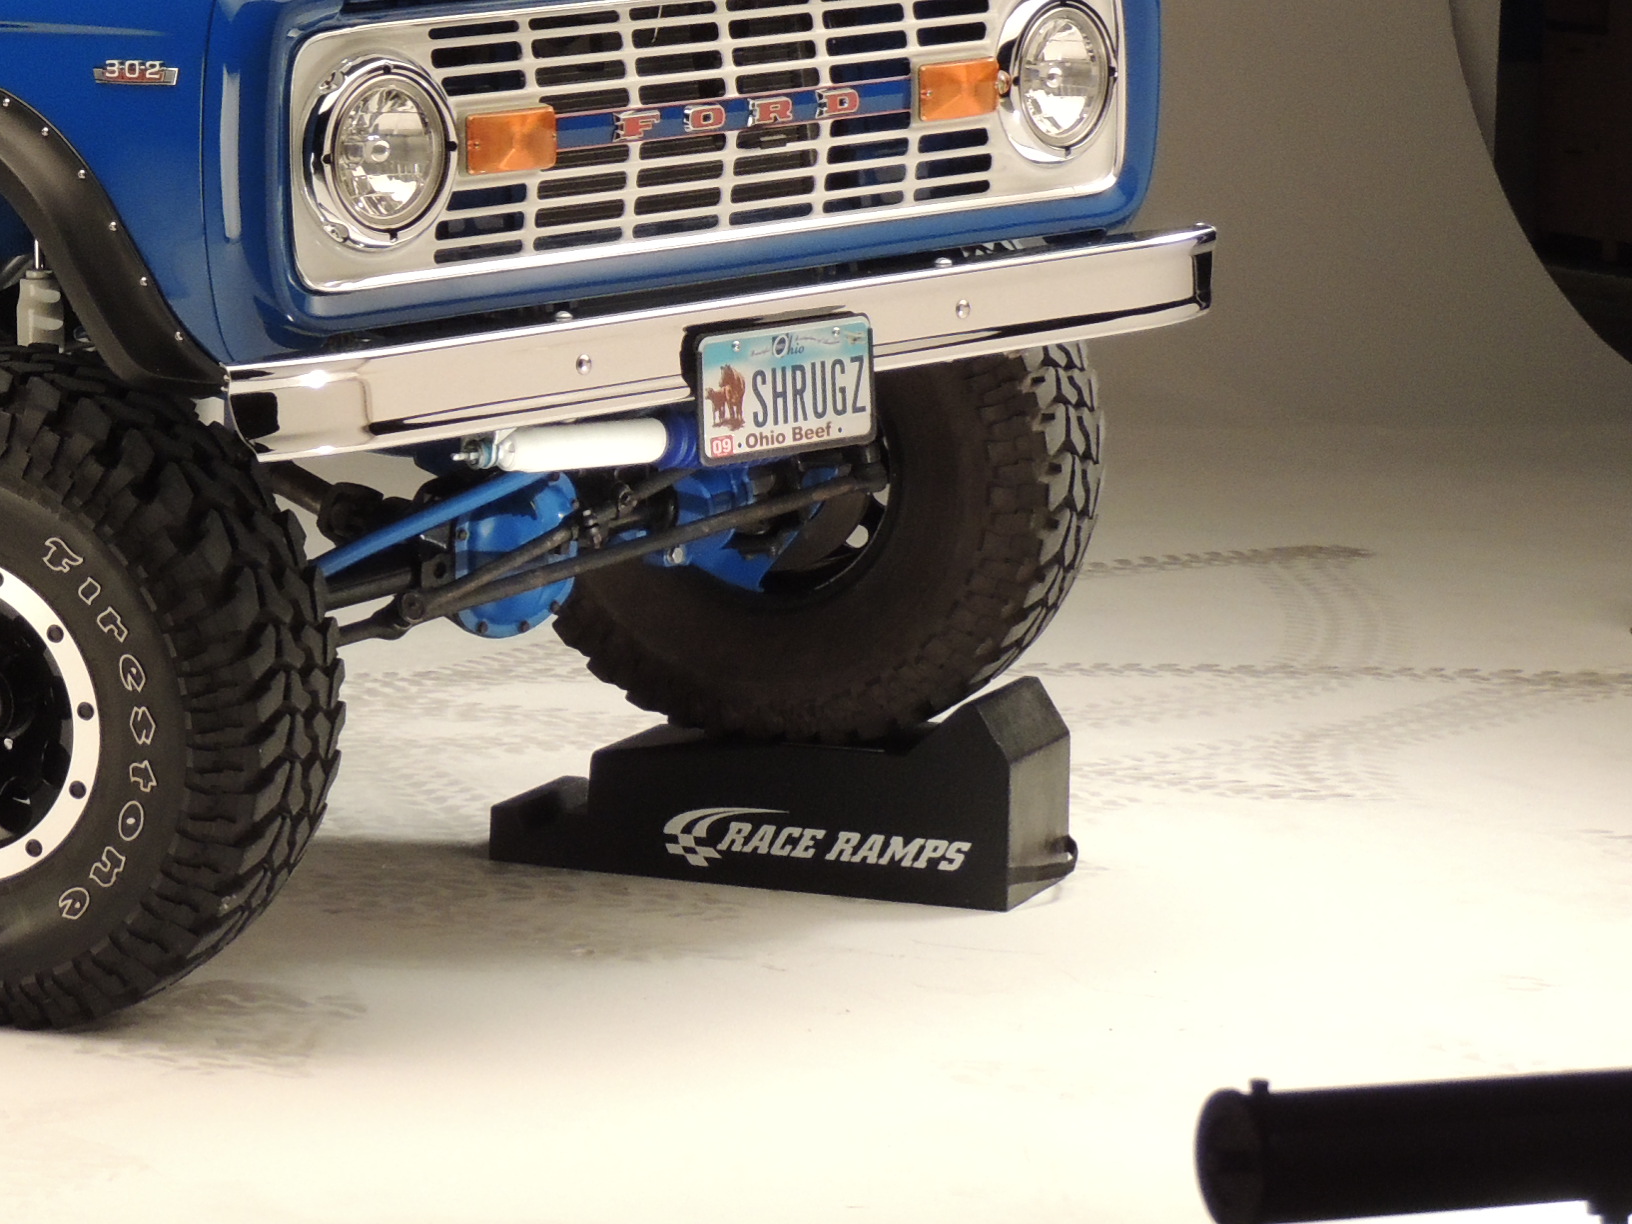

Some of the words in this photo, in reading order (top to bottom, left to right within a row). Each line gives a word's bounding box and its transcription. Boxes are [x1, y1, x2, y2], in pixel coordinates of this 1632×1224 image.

[105, 59, 163, 78] 302
[613, 87, 860, 143] FORD
[772, 332, 805, 358] Ohio
[751, 354, 867, 428] SHRUGZ
[711, 438, 733, 455] 09
[745, 430, 786, 449] Ohio
[792, 421, 832, 442] Beef
[42, 536, 158, 921] Firestone
[717, 821, 827, 860] RACE
[824, 830, 973, 872] RAMPS
